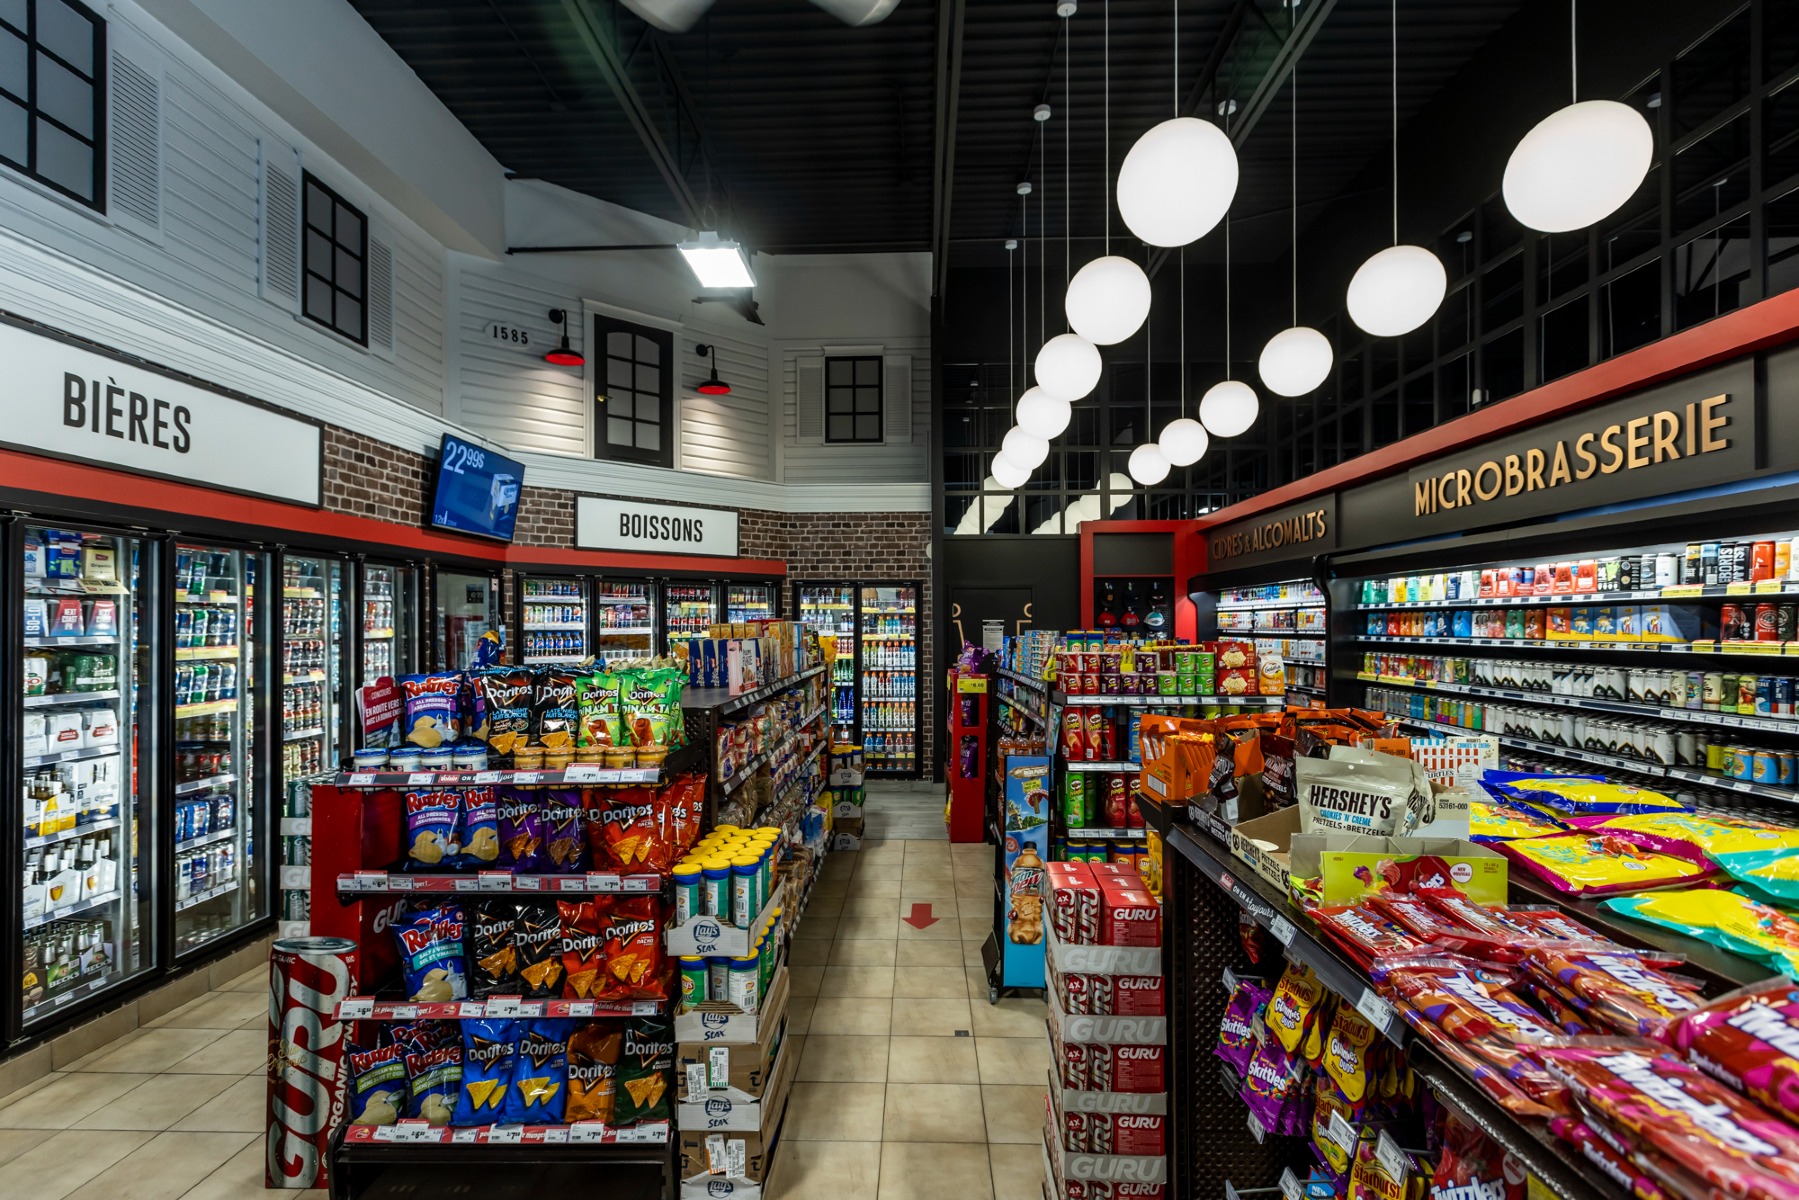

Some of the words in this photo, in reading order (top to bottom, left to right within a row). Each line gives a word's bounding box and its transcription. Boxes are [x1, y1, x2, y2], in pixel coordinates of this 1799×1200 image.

[492, 325, 529, 345] 1585
[63, 370, 192, 455] BIÈRES
[1415, 393, 1732, 517] MICROBRASSERIE
[620, 513, 703, 543] BOISSONS
[1212, 532, 1243, 561] CIDRES
[1245, 535, 1251, 553] &
[1252, 509, 1326, 552] ALCOMALTS
[401, 677, 461, 699] Ruffles
[486, 684, 532, 699] Doritos
[582, 689, 618, 700] Doritos
[629, 690, 666, 700] Doritos
[406, 790, 461, 814] Ruffles
[1310, 784, 1392, 819] HERSHEY'S
[602, 802, 653, 824] Doritos
[1320, 809, 1342, 821] COOKIES
[1261, 852, 1280, 872] PRETZELS
[1261, 863, 1281, 883] BRETZELS
[1057, 894, 1069, 903] 4X
[373, 898, 408, 934] GUR
[1113, 908, 1157, 921] GURU
[401, 920, 463, 955] Ruffles
[605, 920, 655, 940] Doritos
[1064, 948, 1155, 973] GURU
[1068, 981, 1081, 990] 4X
[1118, 978, 1161, 990] GURU
[1070, 1018, 1160, 1042] GURU
[1220, 1017, 1251, 1039] Skittles
[468, 1042, 514, 1061] Doritos
[519, 1039, 566, 1057] Doritos
[624, 1042, 674, 1057] Doritos
[1067, 1050, 1080, 1058] 4X
[1118, 1047, 1161, 1060] GURU
[568, 1064, 617, 1080] Doritos
[1247, 1060, 1286, 1091] Skittles
[1077, 1093, 1152, 1113] GURU
[1595, 1051, 1780, 1156] Twizzlers
[1068, 1119, 1081, 1127] 4X
[1118, 1116, 1161, 1129] GURU
[1071, 1156, 1162, 1180] GURU
[1069, 1186, 1082, 1194] 4X
[1118, 1184, 1160, 1196] GURU
[1353, 1163, 1402, 1199] Starburst
